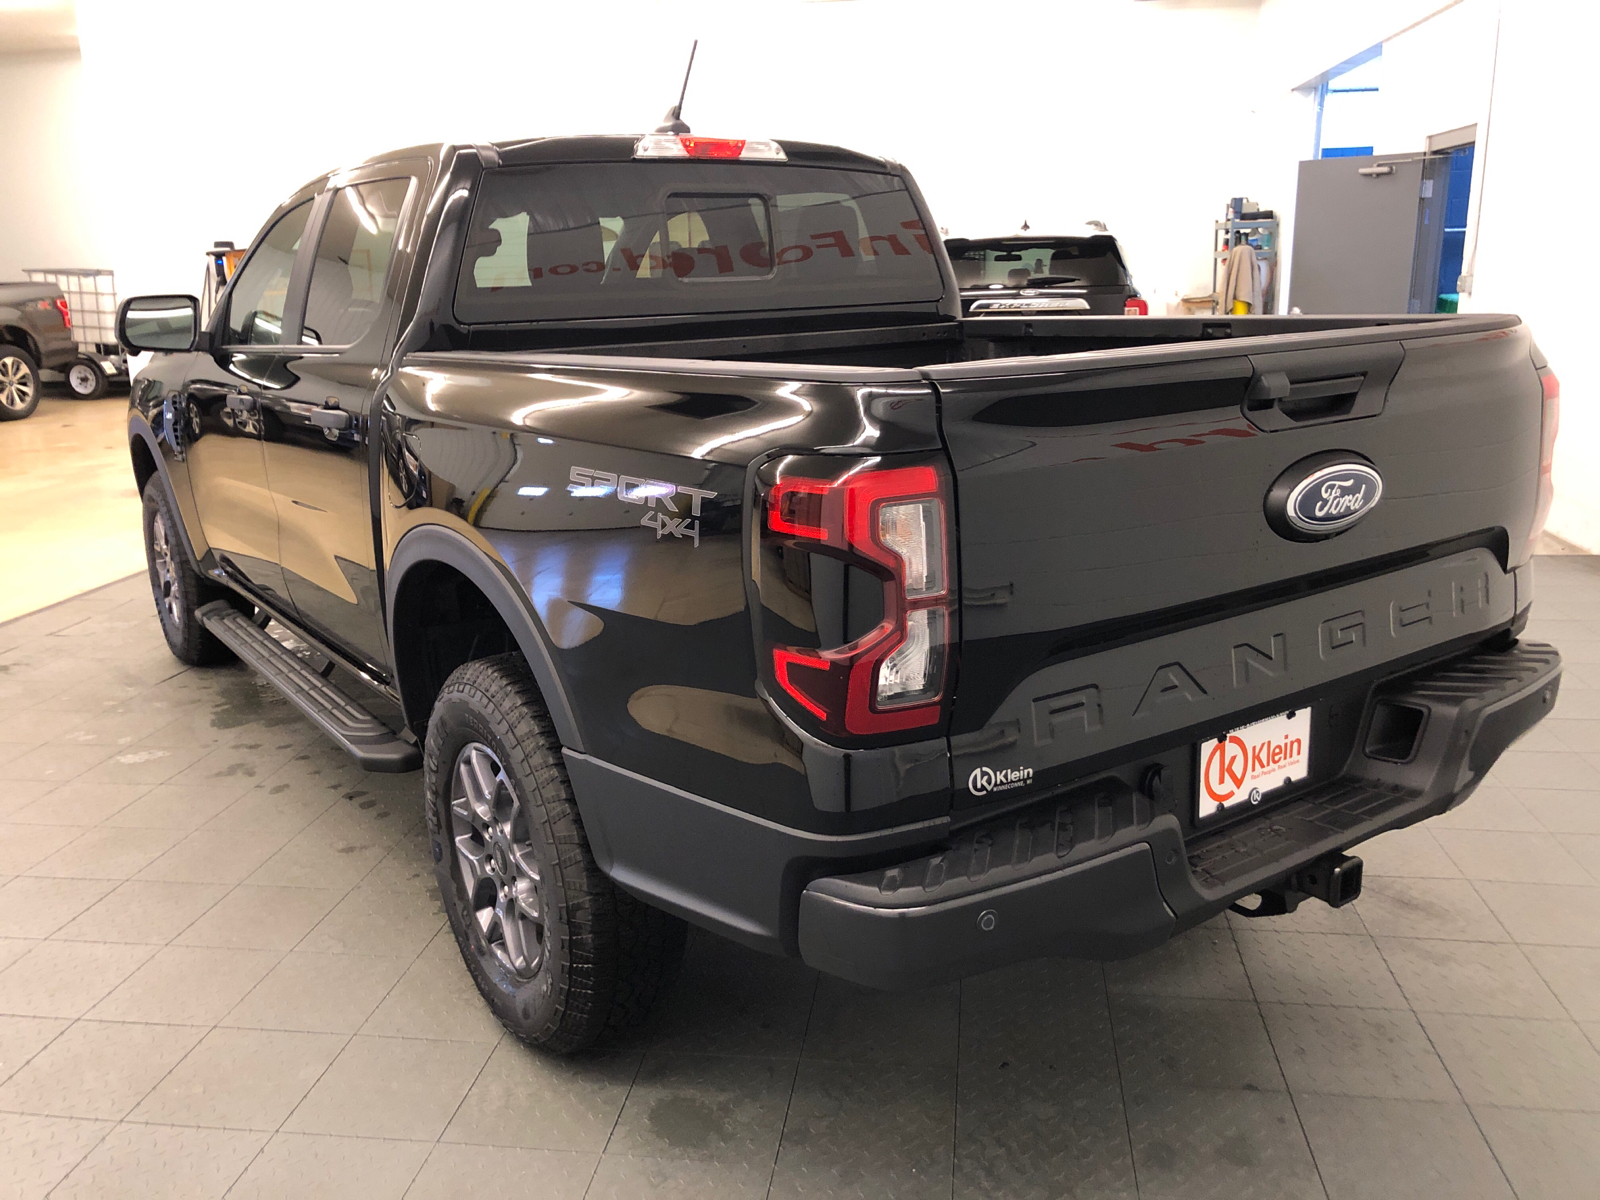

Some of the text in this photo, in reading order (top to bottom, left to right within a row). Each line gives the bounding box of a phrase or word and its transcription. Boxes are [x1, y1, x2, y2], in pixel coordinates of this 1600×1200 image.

[567, 466, 717, 516] SPORT
[1315, 479, 1365, 517] Ford
[1031, 571, 1491, 747] RANGER
[1251, 734, 1302, 773] Klein
[996, 766, 1033, 785] Klein
